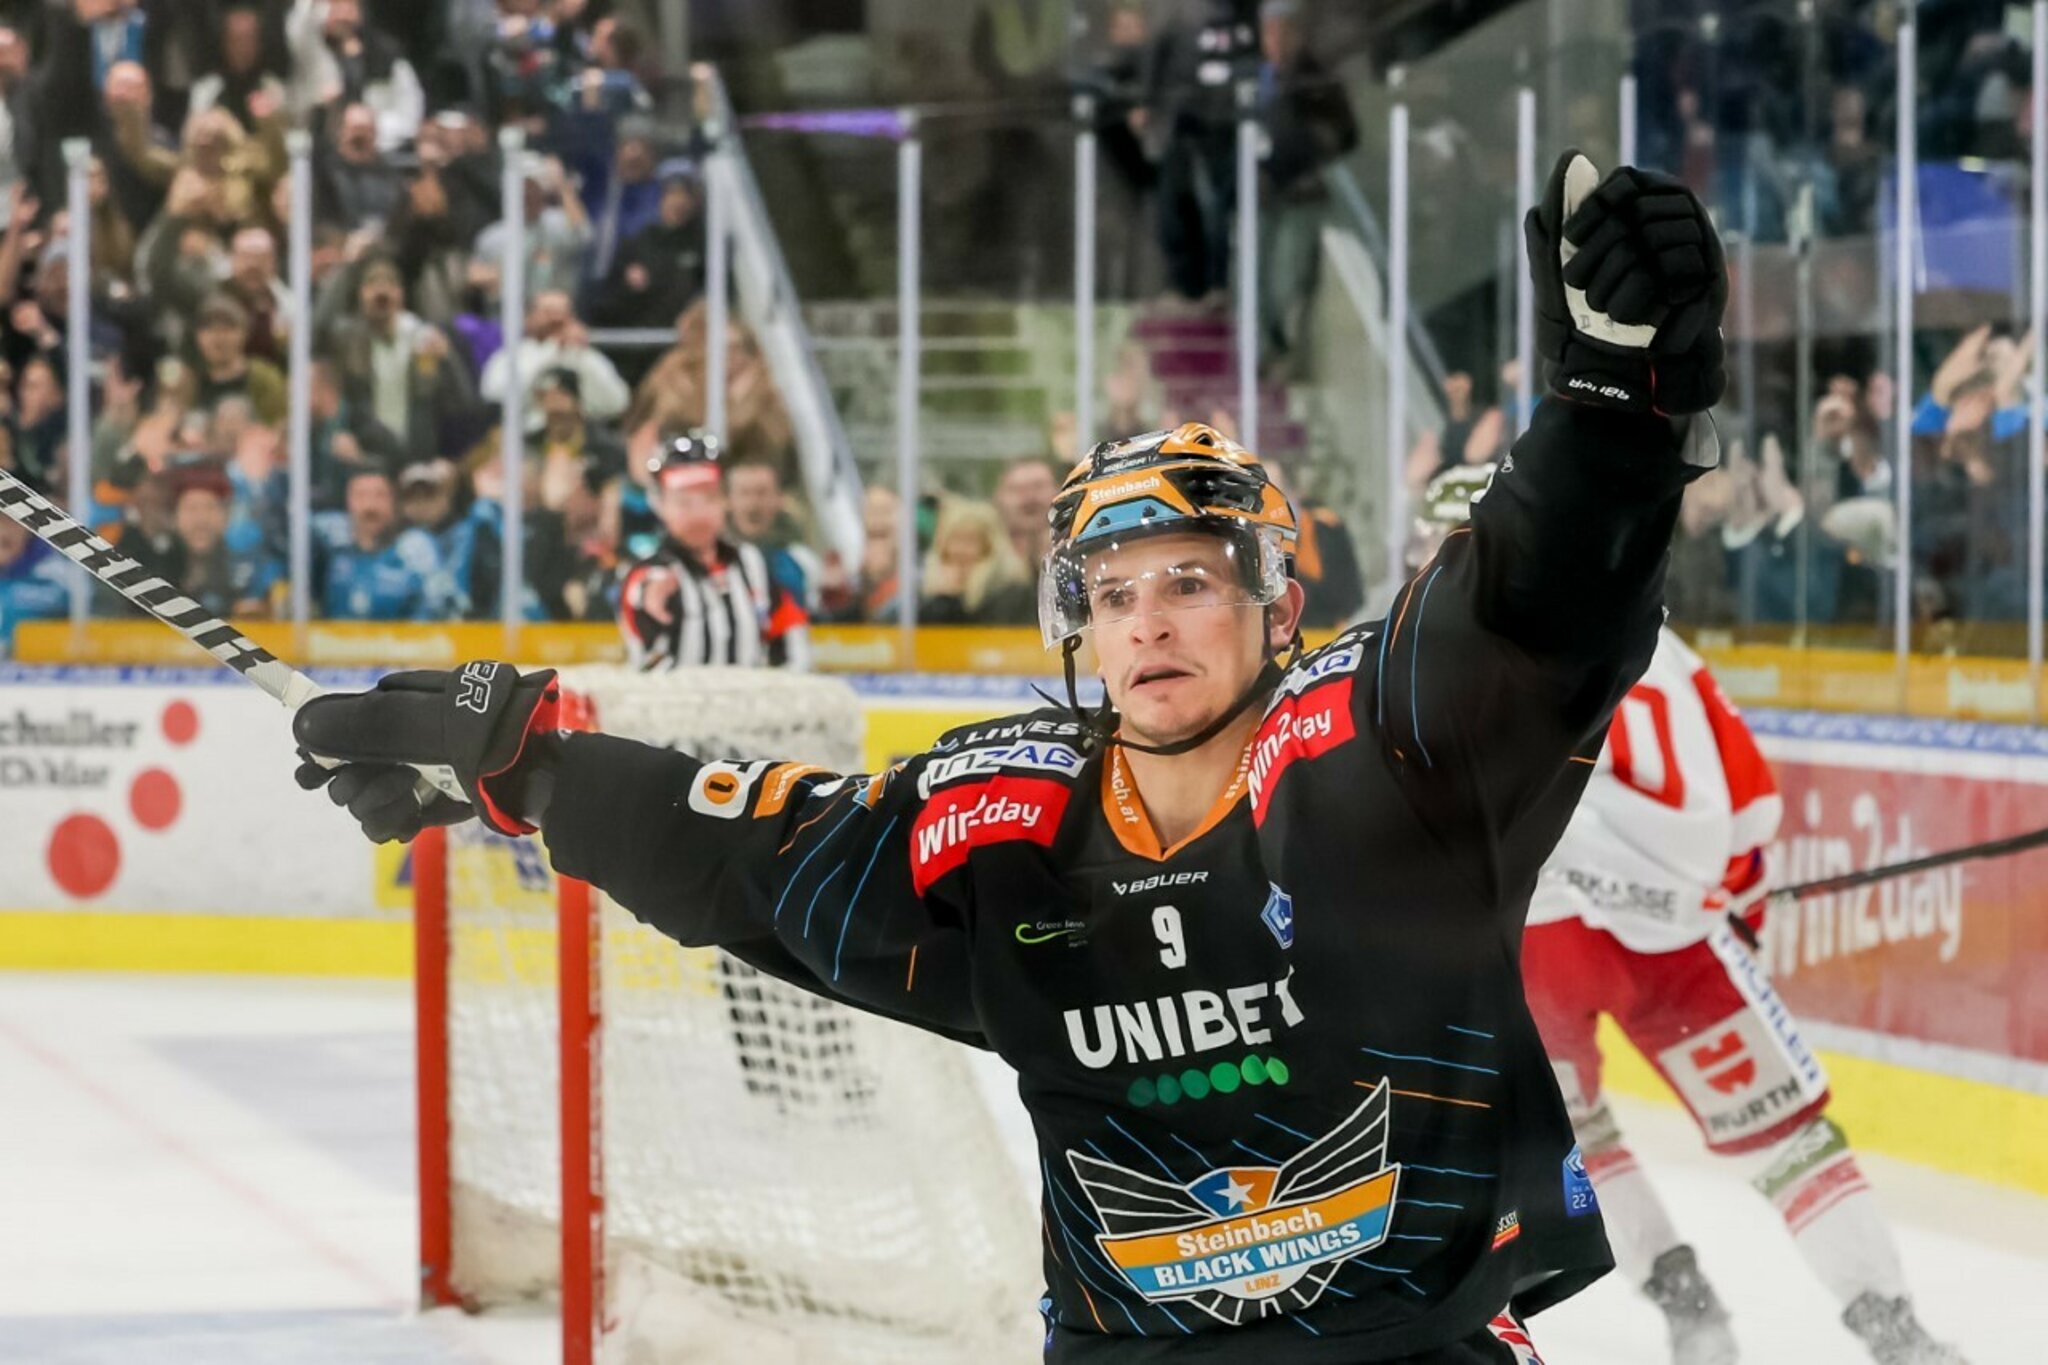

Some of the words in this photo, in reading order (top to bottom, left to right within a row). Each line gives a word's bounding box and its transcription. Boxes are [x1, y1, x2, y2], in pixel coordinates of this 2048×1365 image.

[1090, 476, 1160, 502] Steinbach
[965, 720, 1080, 746] LIWES
[1111, 753, 1140, 824] ach.at
[1128, 870, 1209, 895] BAUER
[1757, 787, 1962, 978] win2day
[1151, 904, 1187, 970] 9
[1063, 963, 1305, 1069] UNIBET
[1153, 1248, 1254, 1289] BLACK
[1258, 1221, 1362, 1269] WINGS
[1175, 1207, 1323, 1259] Steinbach
[1244, 1273, 1282, 1294] LINZ
